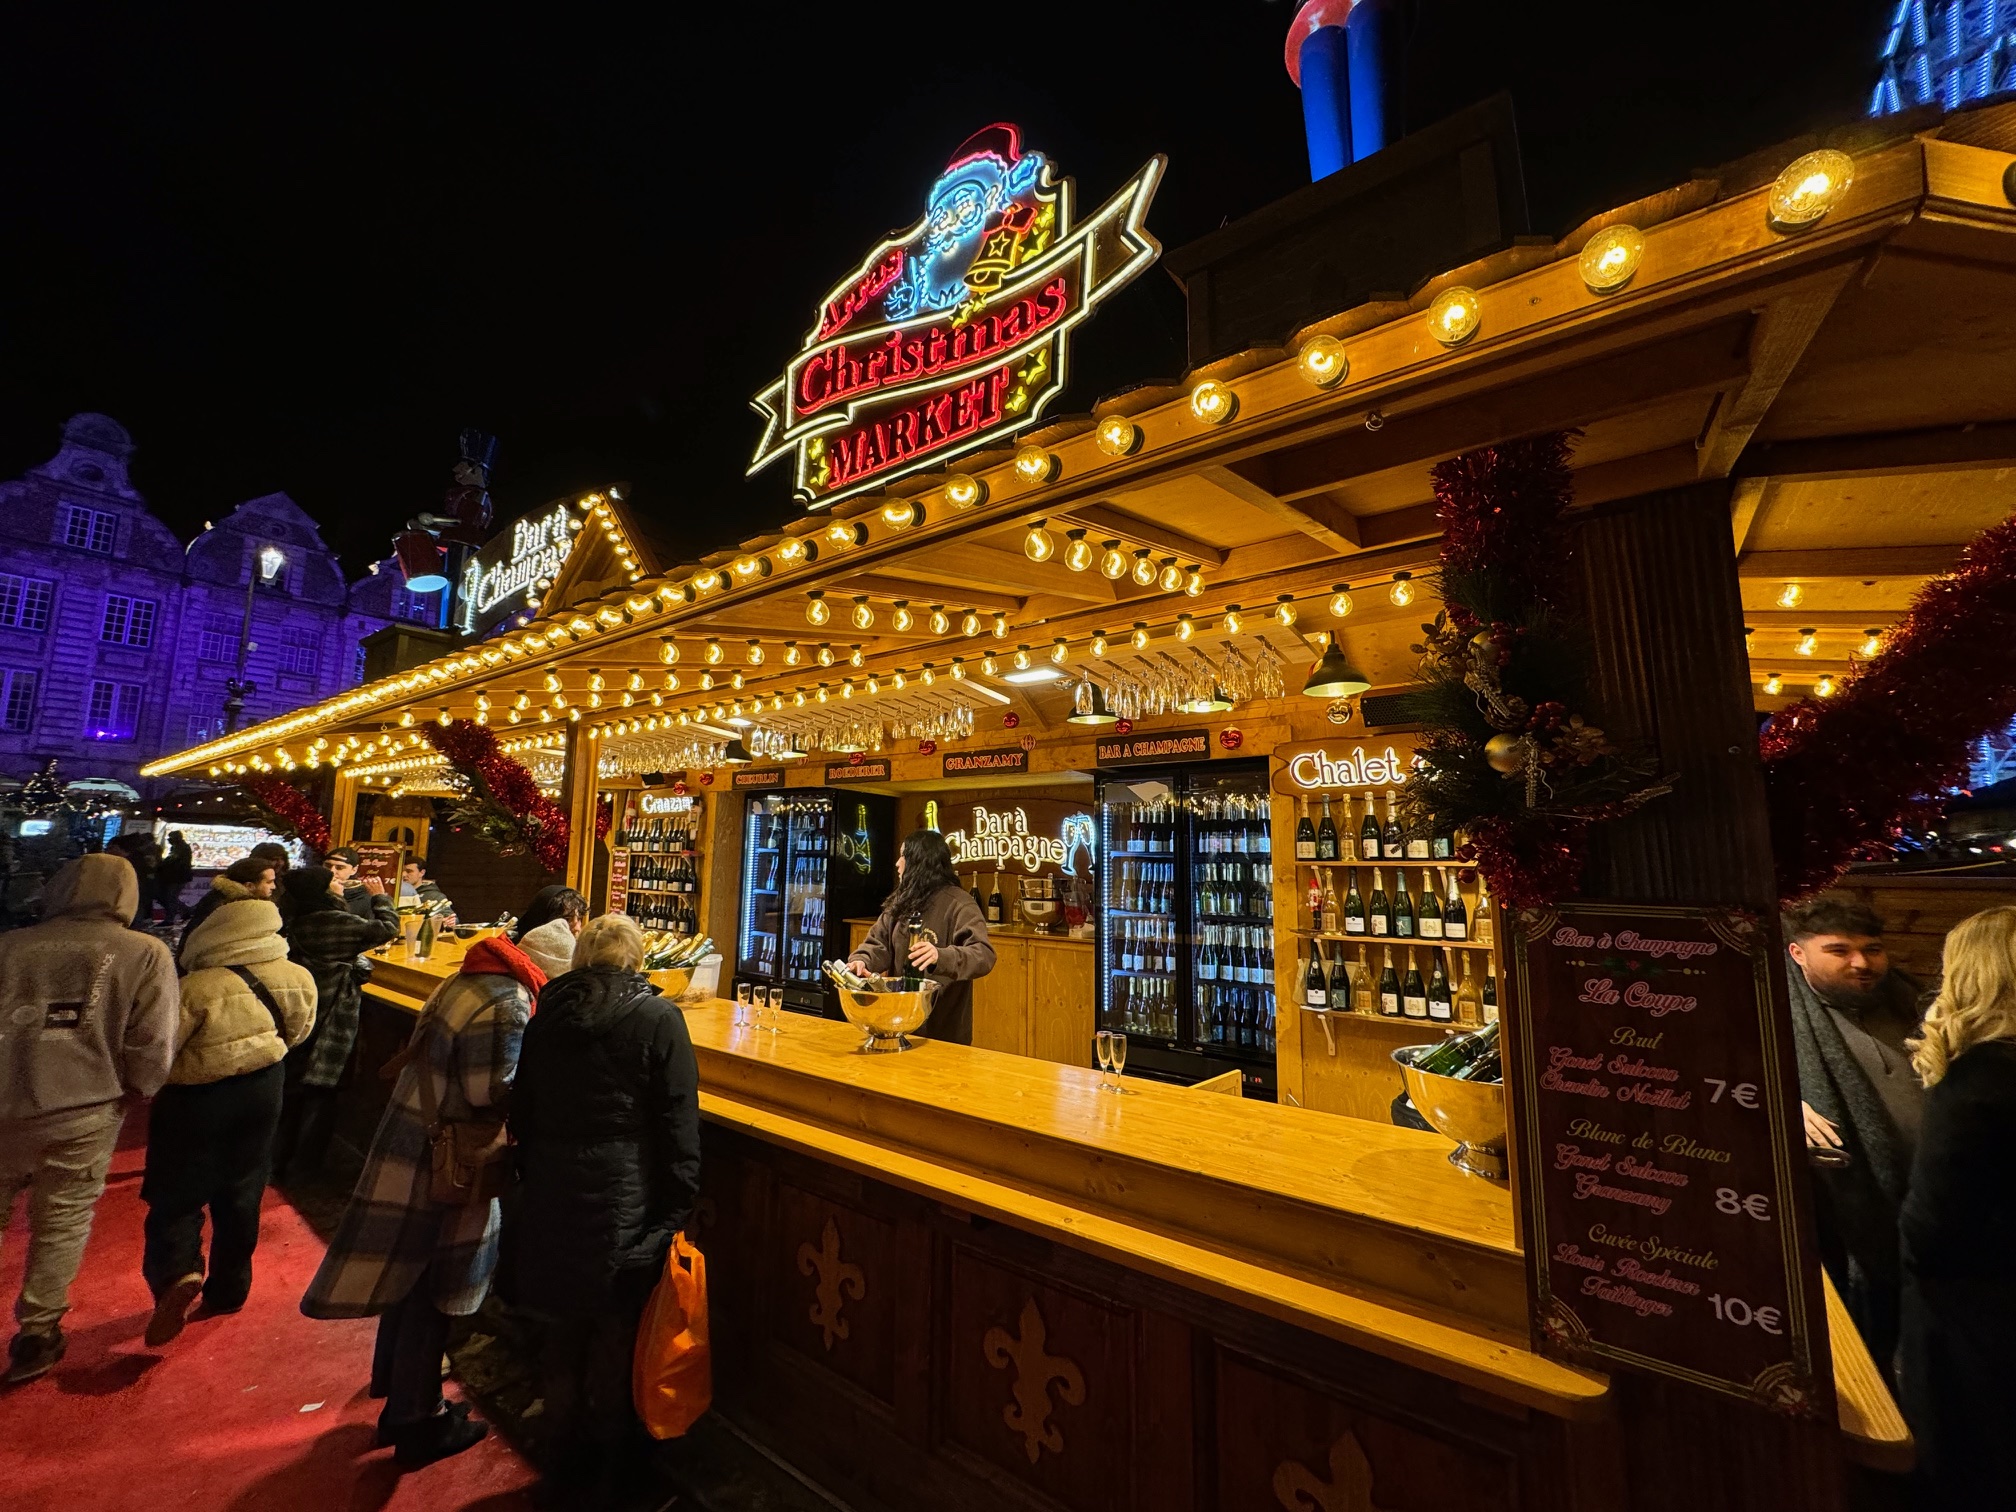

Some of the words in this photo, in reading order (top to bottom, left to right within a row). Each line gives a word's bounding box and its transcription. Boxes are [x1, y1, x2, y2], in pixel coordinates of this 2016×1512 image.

[796, 277, 1067, 415] Christmas
[827, 366, 1009, 490] MARKET
[511, 514, 552, 565] Bar
[946, 753, 1024, 770] GRANZAMY
[1099, 744, 1121, 760] BAR
[1122, 745, 1133, 757] A
[1133, 737, 1206, 757] CHAMPAGNE
[1289, 746, 1407, 789] Chalet
[973, 806, 1013, 837] Bar
[1014, 806, 1029, 836] à
[945, 829, 1067, 873] Champagne
[1552, 927, 1595, 948] Bar
[1596, 932, 1612, 949] à
[1614, 930, 1717, 960] Champagne
[1578, 978, 1620, 1005] La
[1624, 981, 1697, 1017] Coupe
[1549, 1046, 1603, 1072] Gonet
[1609, 1026, 1664, 1050] Brut
[1553, 1143, 1612, 1171] Gonet
[1566, 1118, 1626, 1144] Blanc
[1632, 1131, 1654, 1149] de
[1659, 1133, 1731, 1163] Blancs
[1573, 1172, 1672, 1215] Granzamy
[1715, 1187, 1771, 1221] 8€
[1588, 1223, 1638, 1250] Cuvée
[1639, 1236, 1719, 1270] Spéciale
[1552, 1242, 1606, 1272] Louis
[1610, 1257, 1701, 1296] Roederer
[1580, 1275, 1673, 1317] Taittinger
[1707, 1293, 1783, 1335] 10€
